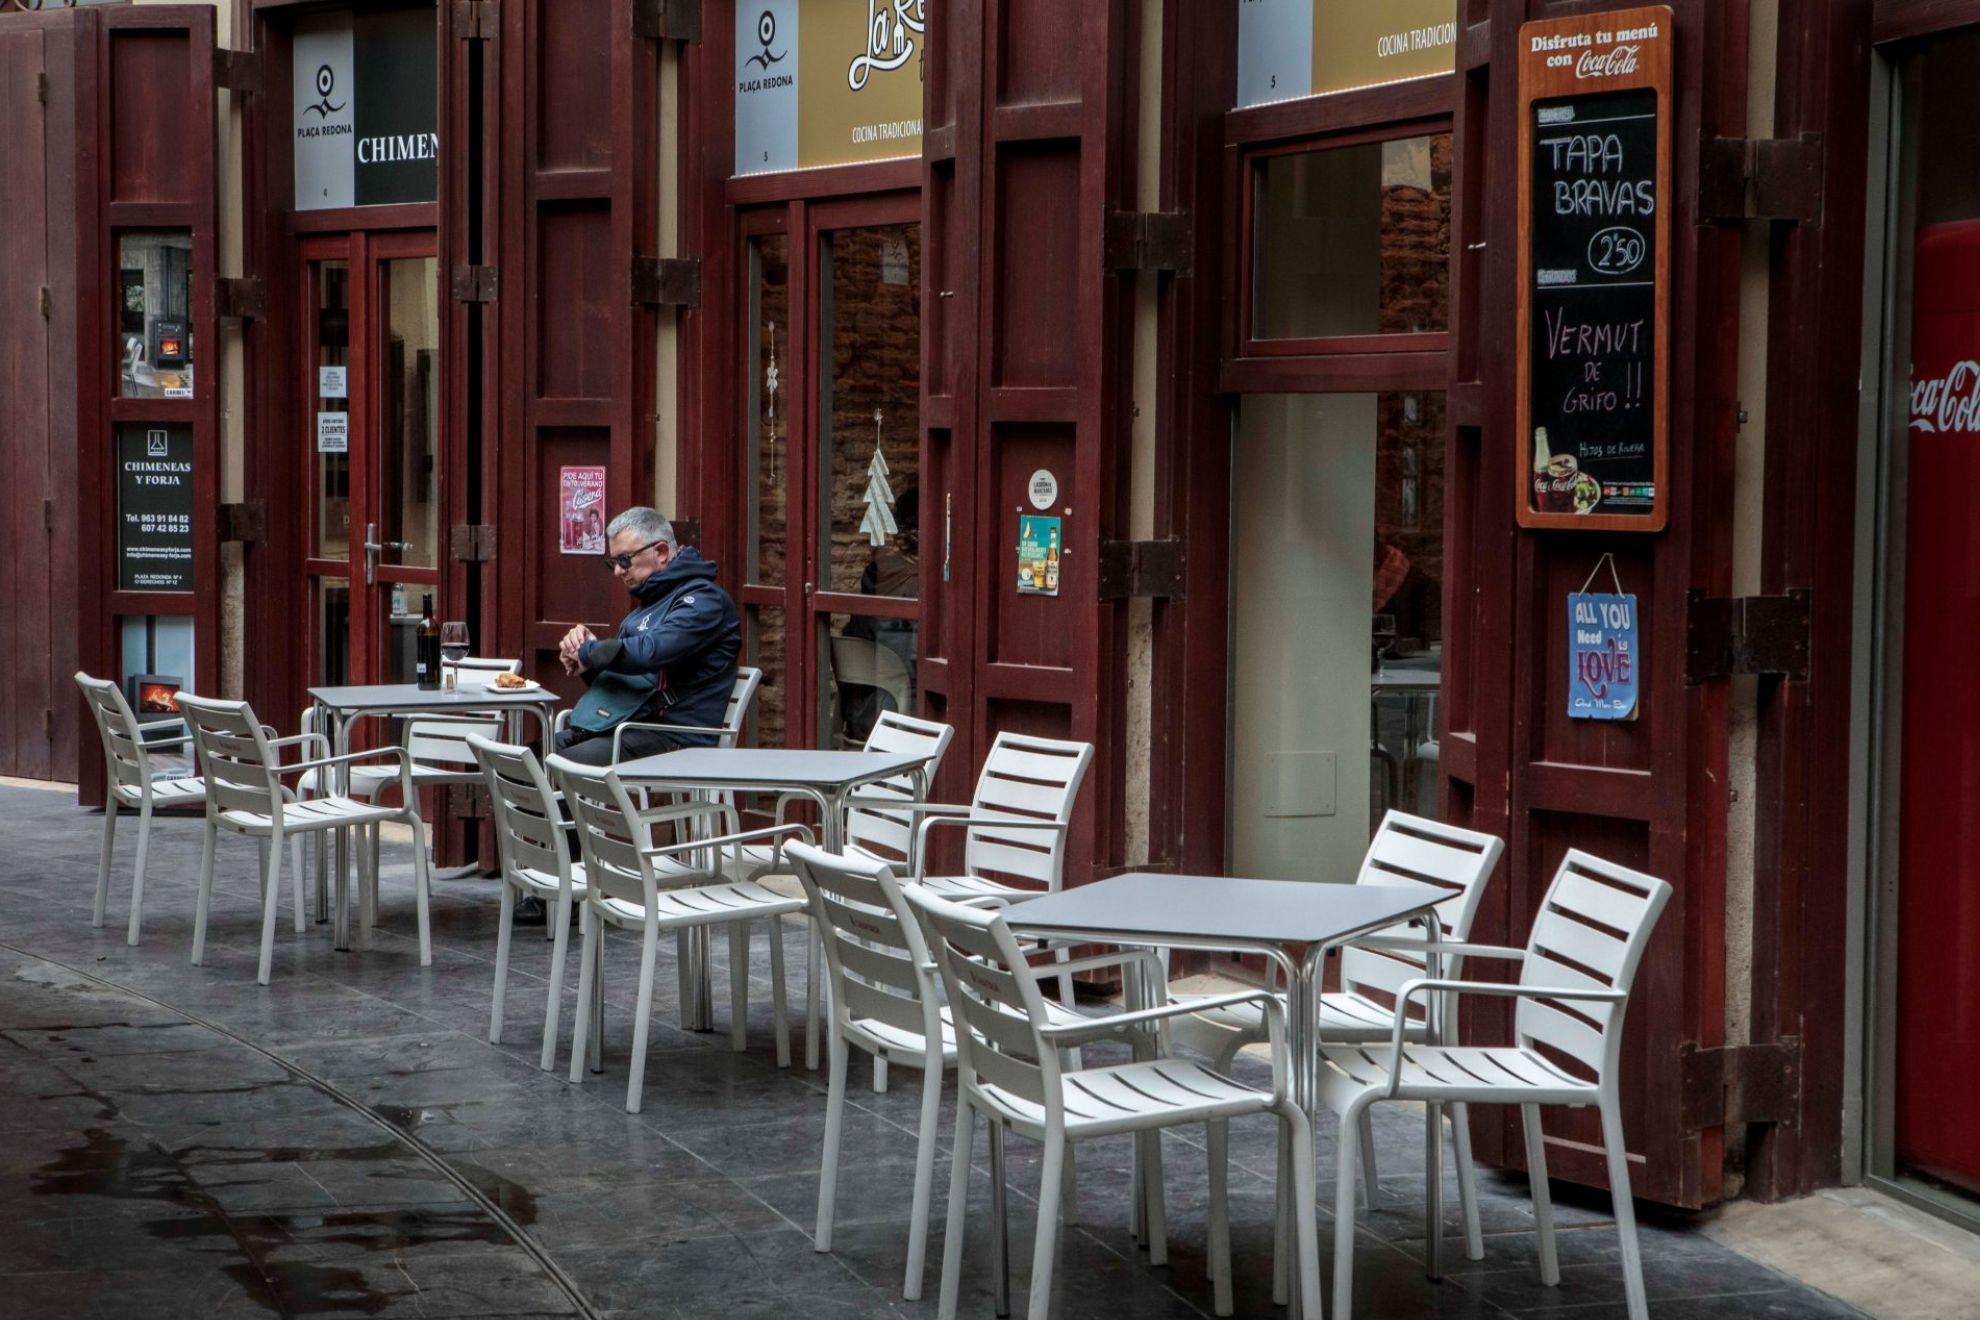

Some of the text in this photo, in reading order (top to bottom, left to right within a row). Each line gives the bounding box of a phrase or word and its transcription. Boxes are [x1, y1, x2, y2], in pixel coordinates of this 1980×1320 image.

[1377, 31, 1409, 57] COCINA
[1531, 22, 1659, 52] Disfruta tu menú
[1547, 45, 1640, 79] con Coca-Cola
[739, 75, 794, 93] PLAÇA REDONA
[1271, 75, 1276, 88] 5
[297, 123, 353, 139] PLAÇA REDONA
[852, 125, 878, 143] COCINA
[763, 151, 769, 162] 5
[1539, 133, 1624, 174] TAPA
[1554, 179, 1655, 217] BRAVAS
[1545, 306, 1645, 360] VERMUT
[1584, 361, 1602, 382] DE
[1563, 386, 1617, 413] GRIFO
[1908, 360, 1980, 432] ca-Col
[124, 461, 192, 472] CHIMENEAS
[595, 472, 603, 480] TU
[135, 475, 180, 485] Y FORJA
[179, 524, 189, 533] 23
[1575, 602, 1631, 631] ALL YOU
[1577, 629, 1628, 650] Need is
[1577, 637, 1631, 698] LOVE
